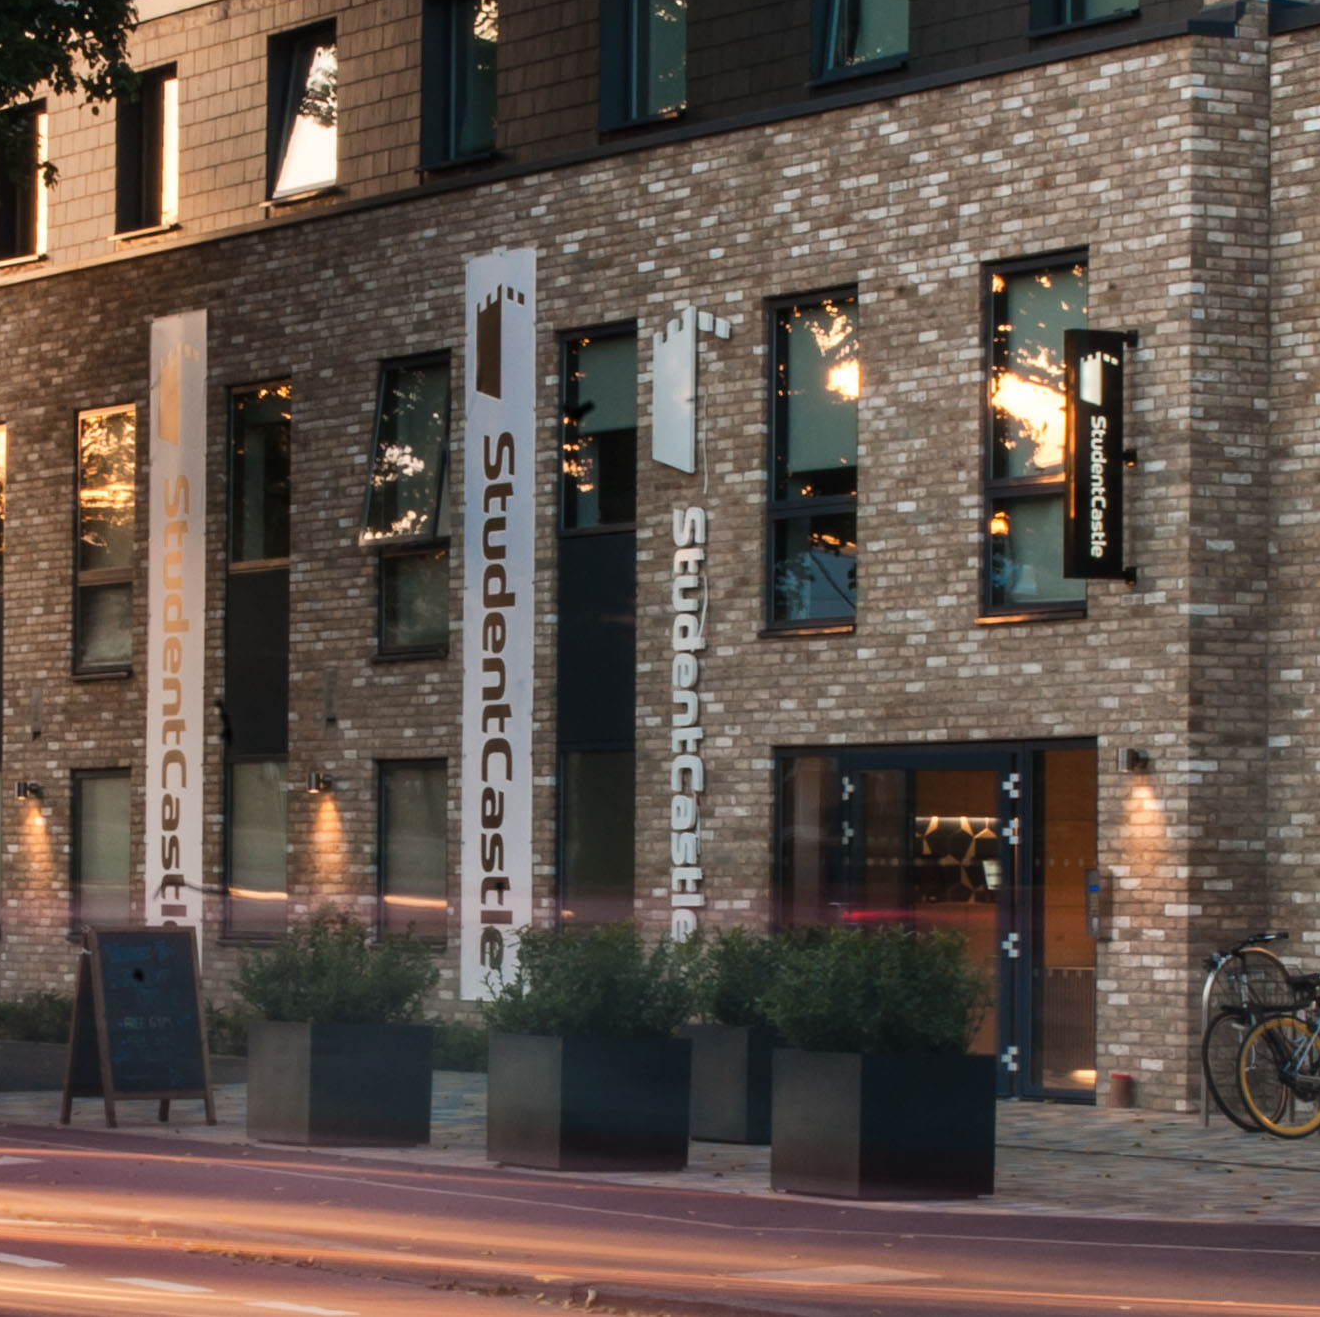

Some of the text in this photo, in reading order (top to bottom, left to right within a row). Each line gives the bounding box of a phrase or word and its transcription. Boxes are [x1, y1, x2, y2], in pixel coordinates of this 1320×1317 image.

[161, 474, 191, 926] StudentCastl
[479, 431, 516, 971] StudentCastle
[1091, 415, 1107, 558] StudentCastle
[671, 507, 706, 943] StudentCastle
